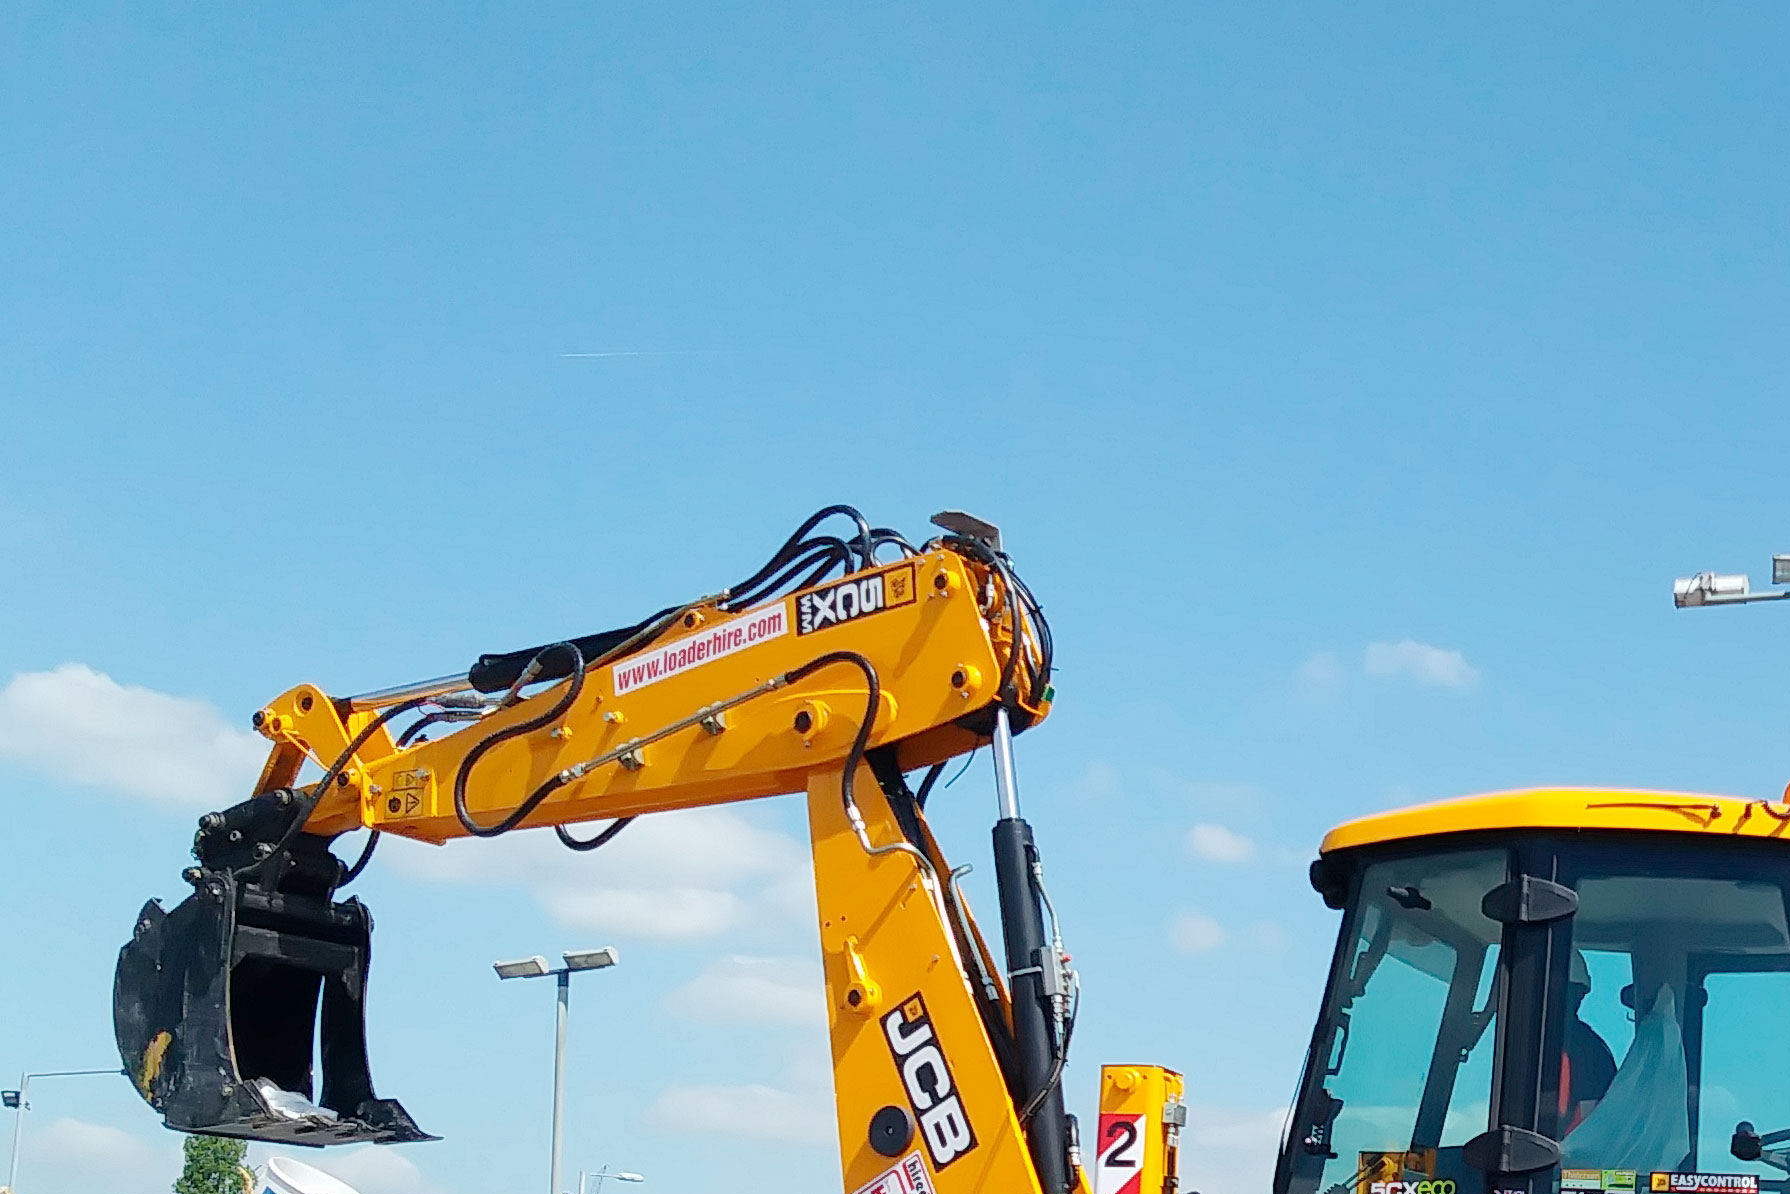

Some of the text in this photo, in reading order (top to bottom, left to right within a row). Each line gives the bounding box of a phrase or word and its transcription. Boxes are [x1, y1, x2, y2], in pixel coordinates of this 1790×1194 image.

[617, 611, 783, 691] www.loaderhire.com
[886, 1010, 971, 1164] JCB
[1104, 1121, 1138, 1168] 2
[1670, 1174, 1758, 1190] EASYCONTROL
